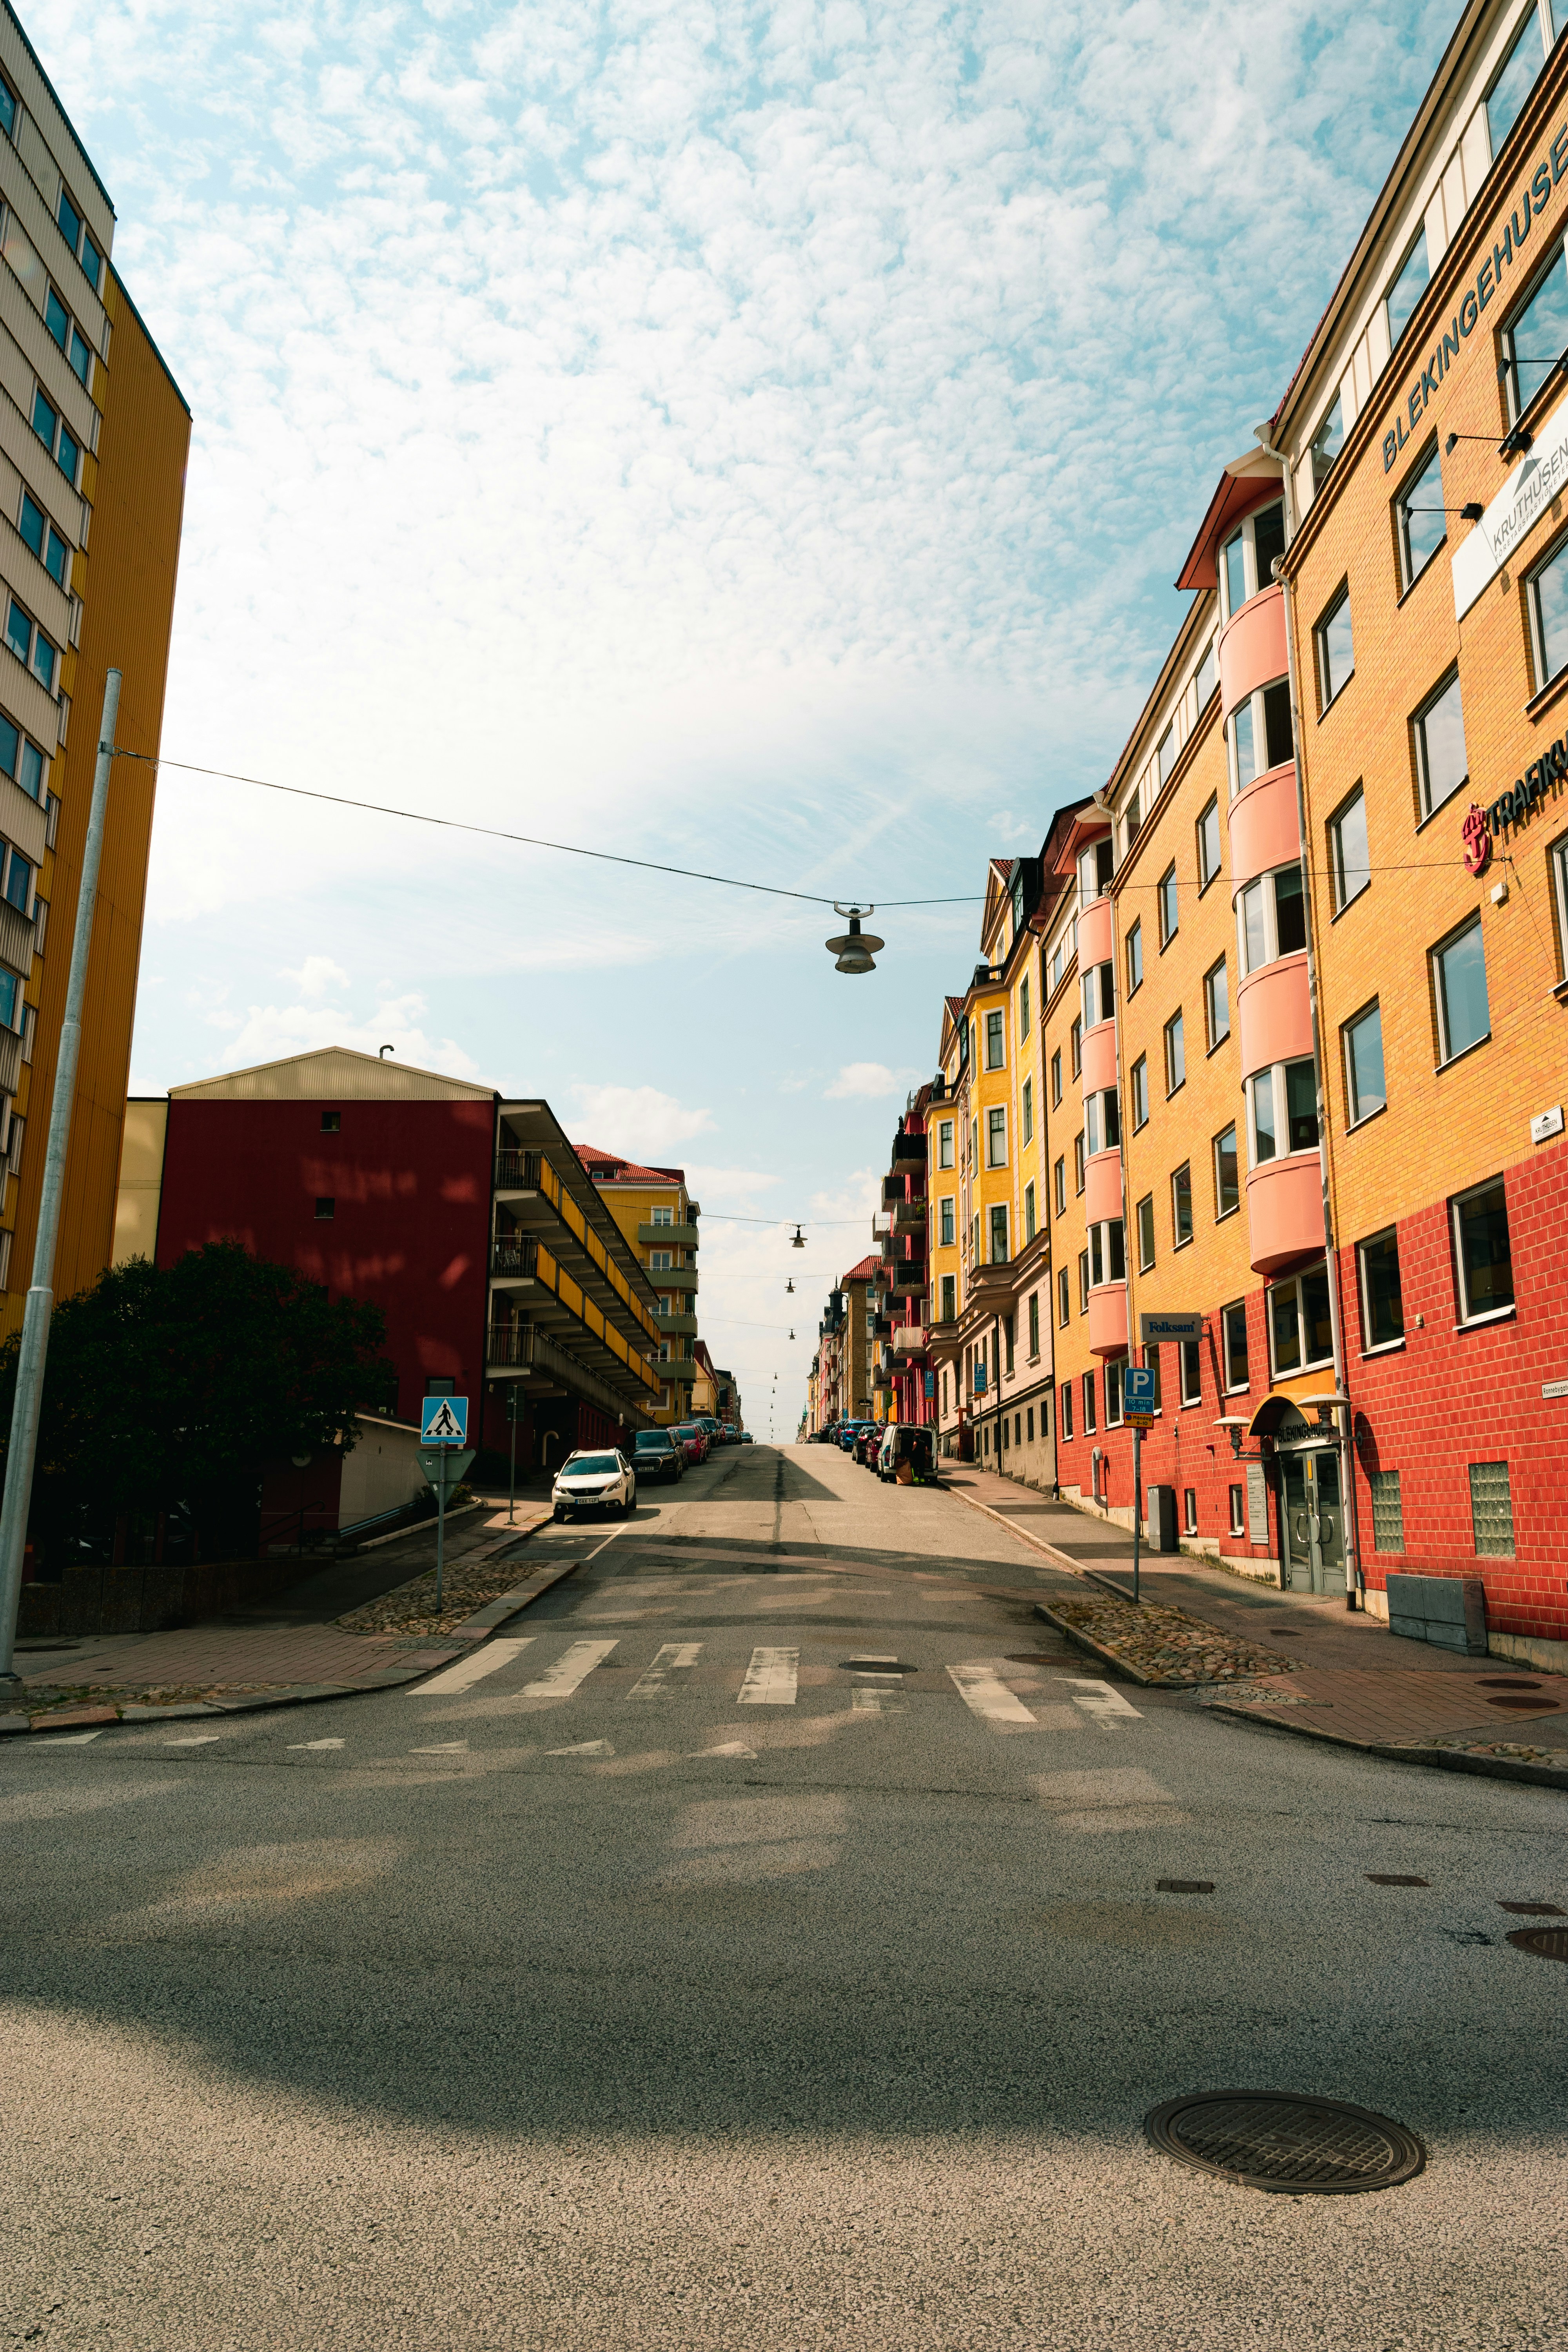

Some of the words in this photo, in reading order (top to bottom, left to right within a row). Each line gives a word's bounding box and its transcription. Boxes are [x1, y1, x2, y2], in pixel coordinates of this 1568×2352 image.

[1494, 437, 1568, 552] KRUTHUSEN
[1535, 1118, 1557, 1134] KRUTHUSEN
[1149, 1322, 1194, 1332] Folksam
[977, 1365, 983, 1374] P
[1133, 1372, 1149, 1394] P
